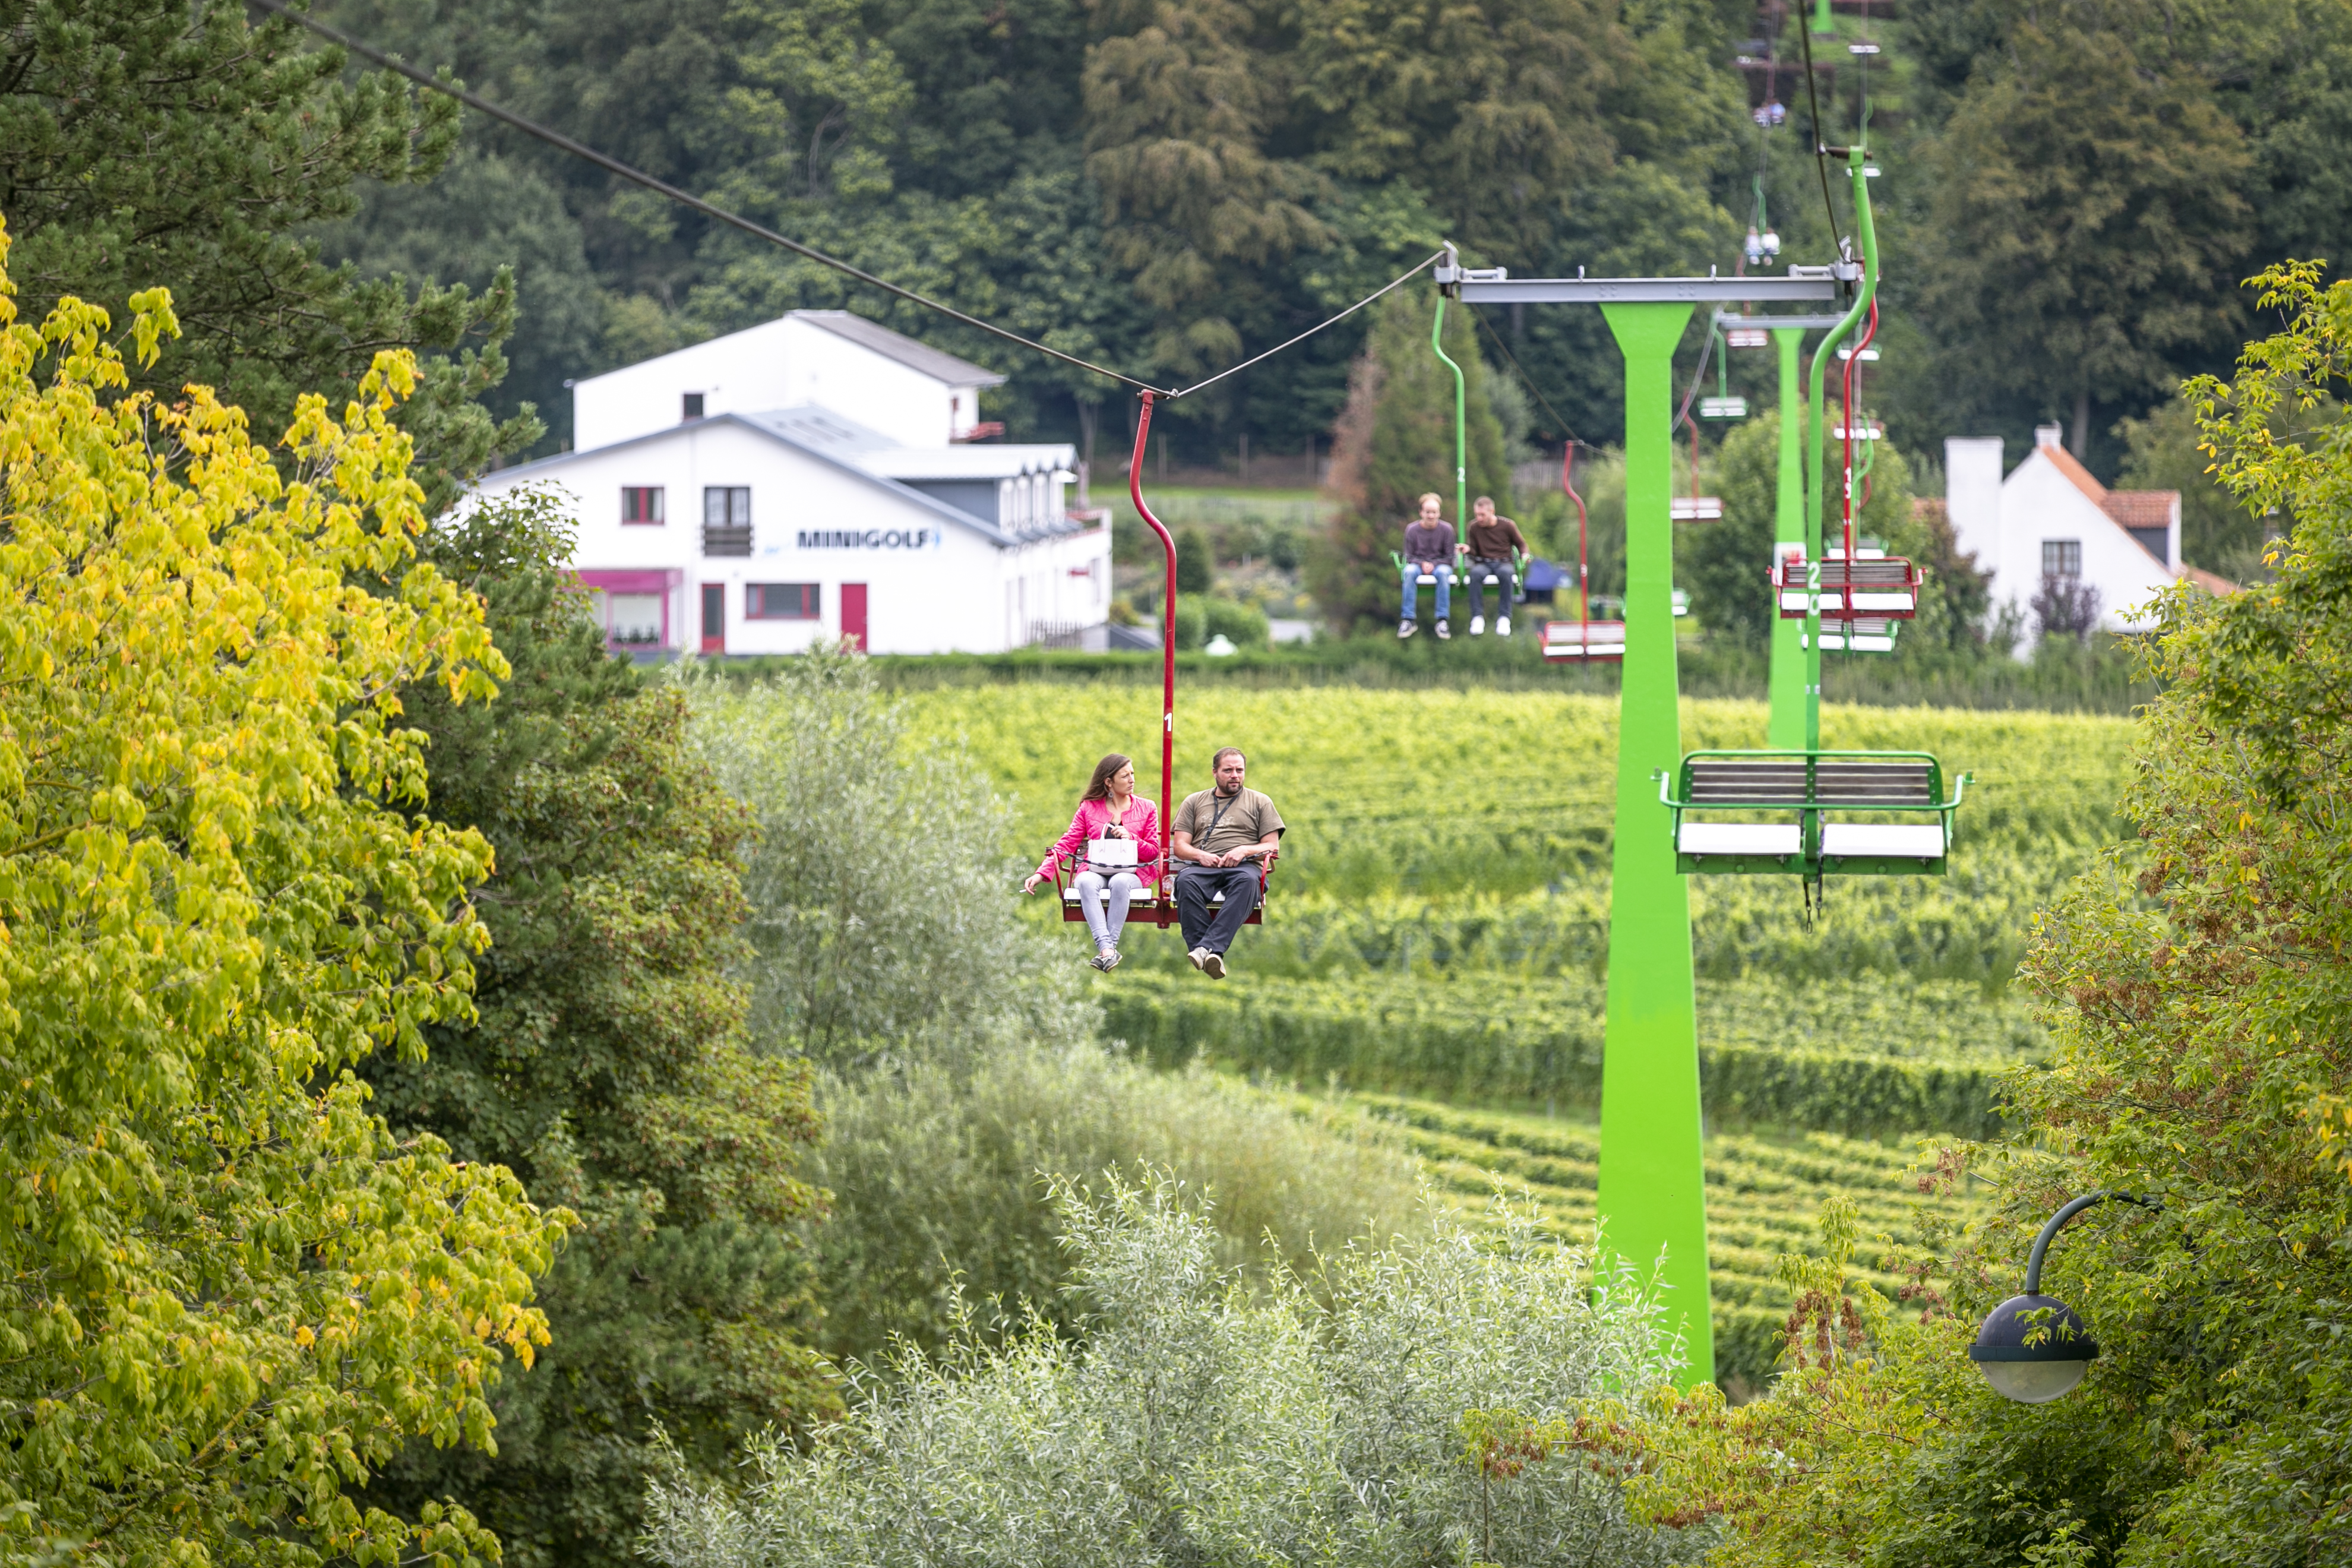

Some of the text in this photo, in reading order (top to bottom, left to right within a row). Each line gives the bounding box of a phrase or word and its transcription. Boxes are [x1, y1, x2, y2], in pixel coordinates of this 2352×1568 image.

[1458, 467, 1465, 482] 2
[798, 530, 928, 548] MINIGOLF
[1164, 712, 1173, 732] 1
